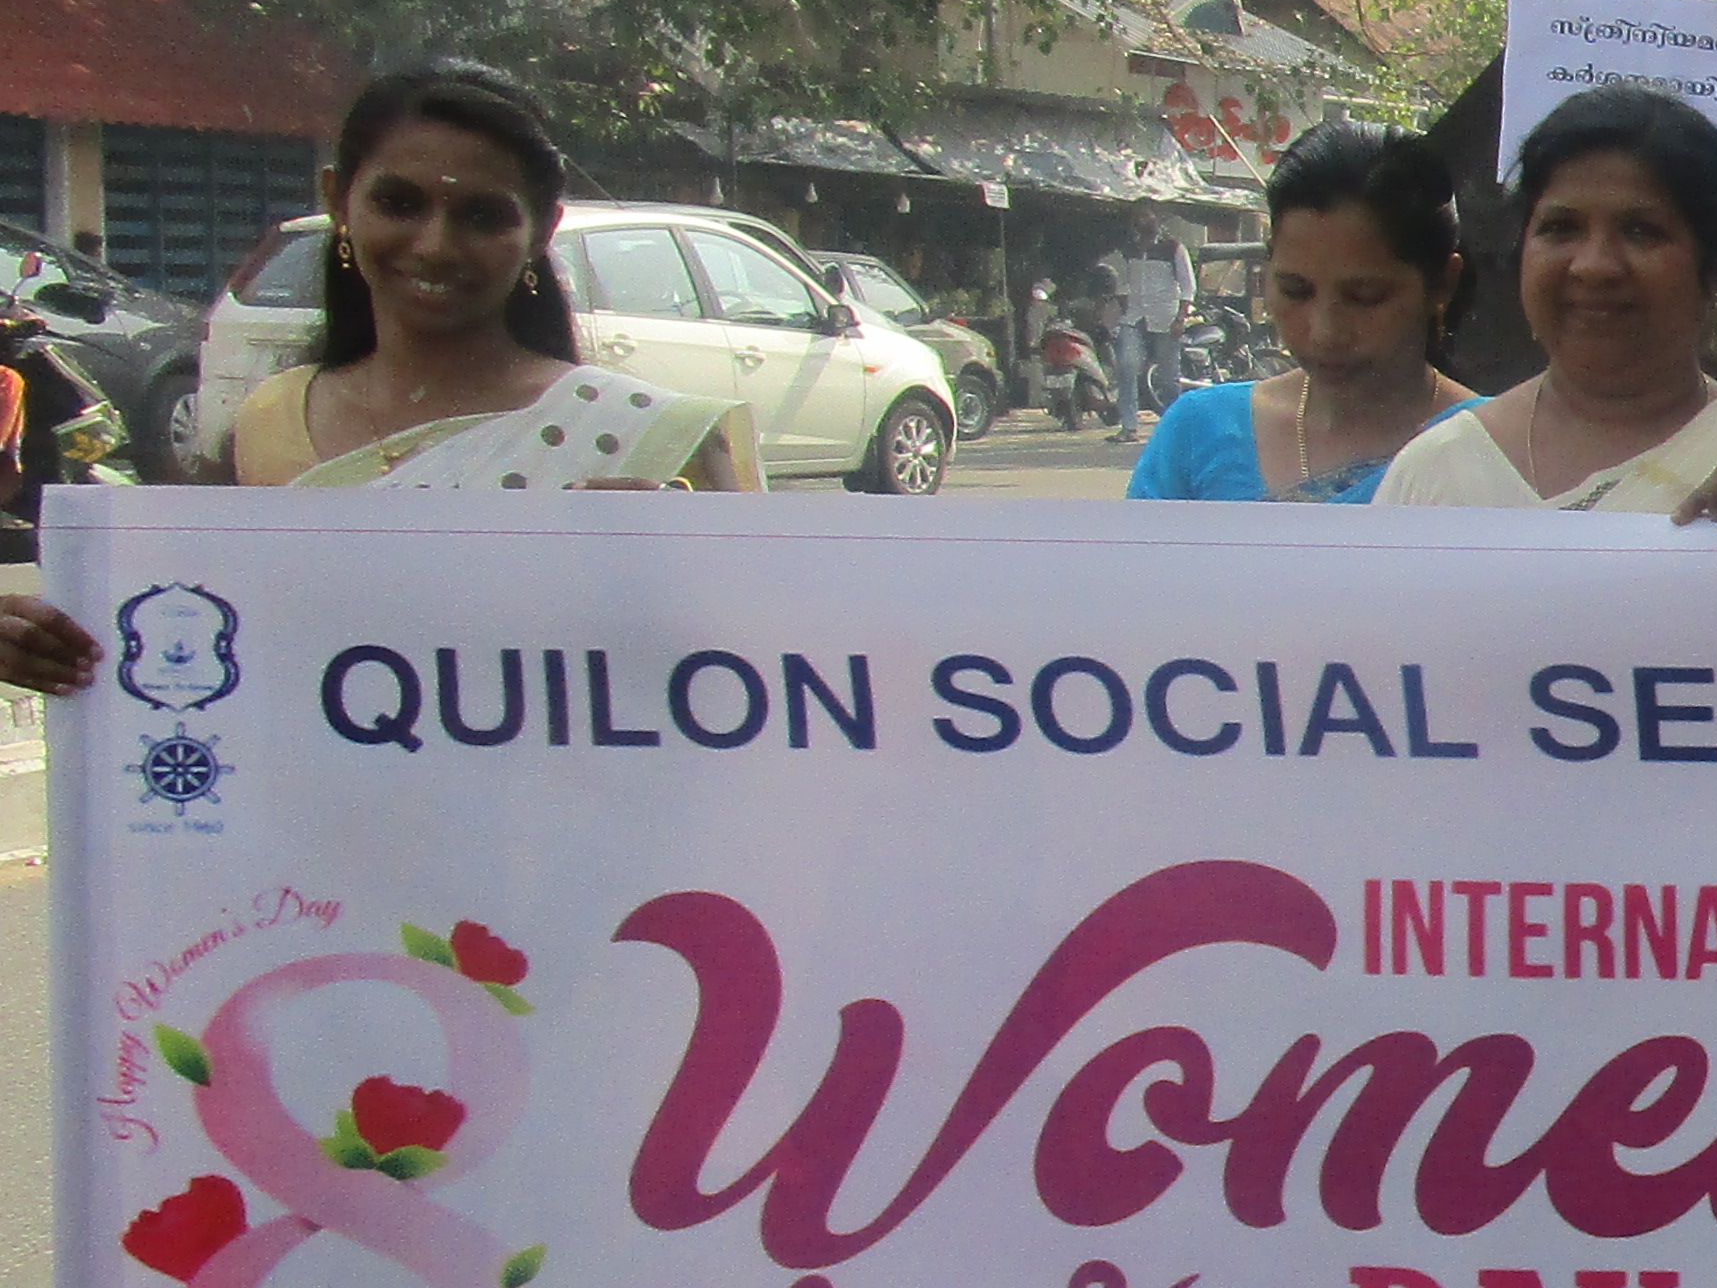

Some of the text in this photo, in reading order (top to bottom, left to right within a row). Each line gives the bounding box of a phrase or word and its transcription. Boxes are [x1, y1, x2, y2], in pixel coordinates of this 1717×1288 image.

[321, 644, 876, 753] QUILON
[932, 655, 1480, 759] SOCIAL
[252, 884, 344, 932] Day
